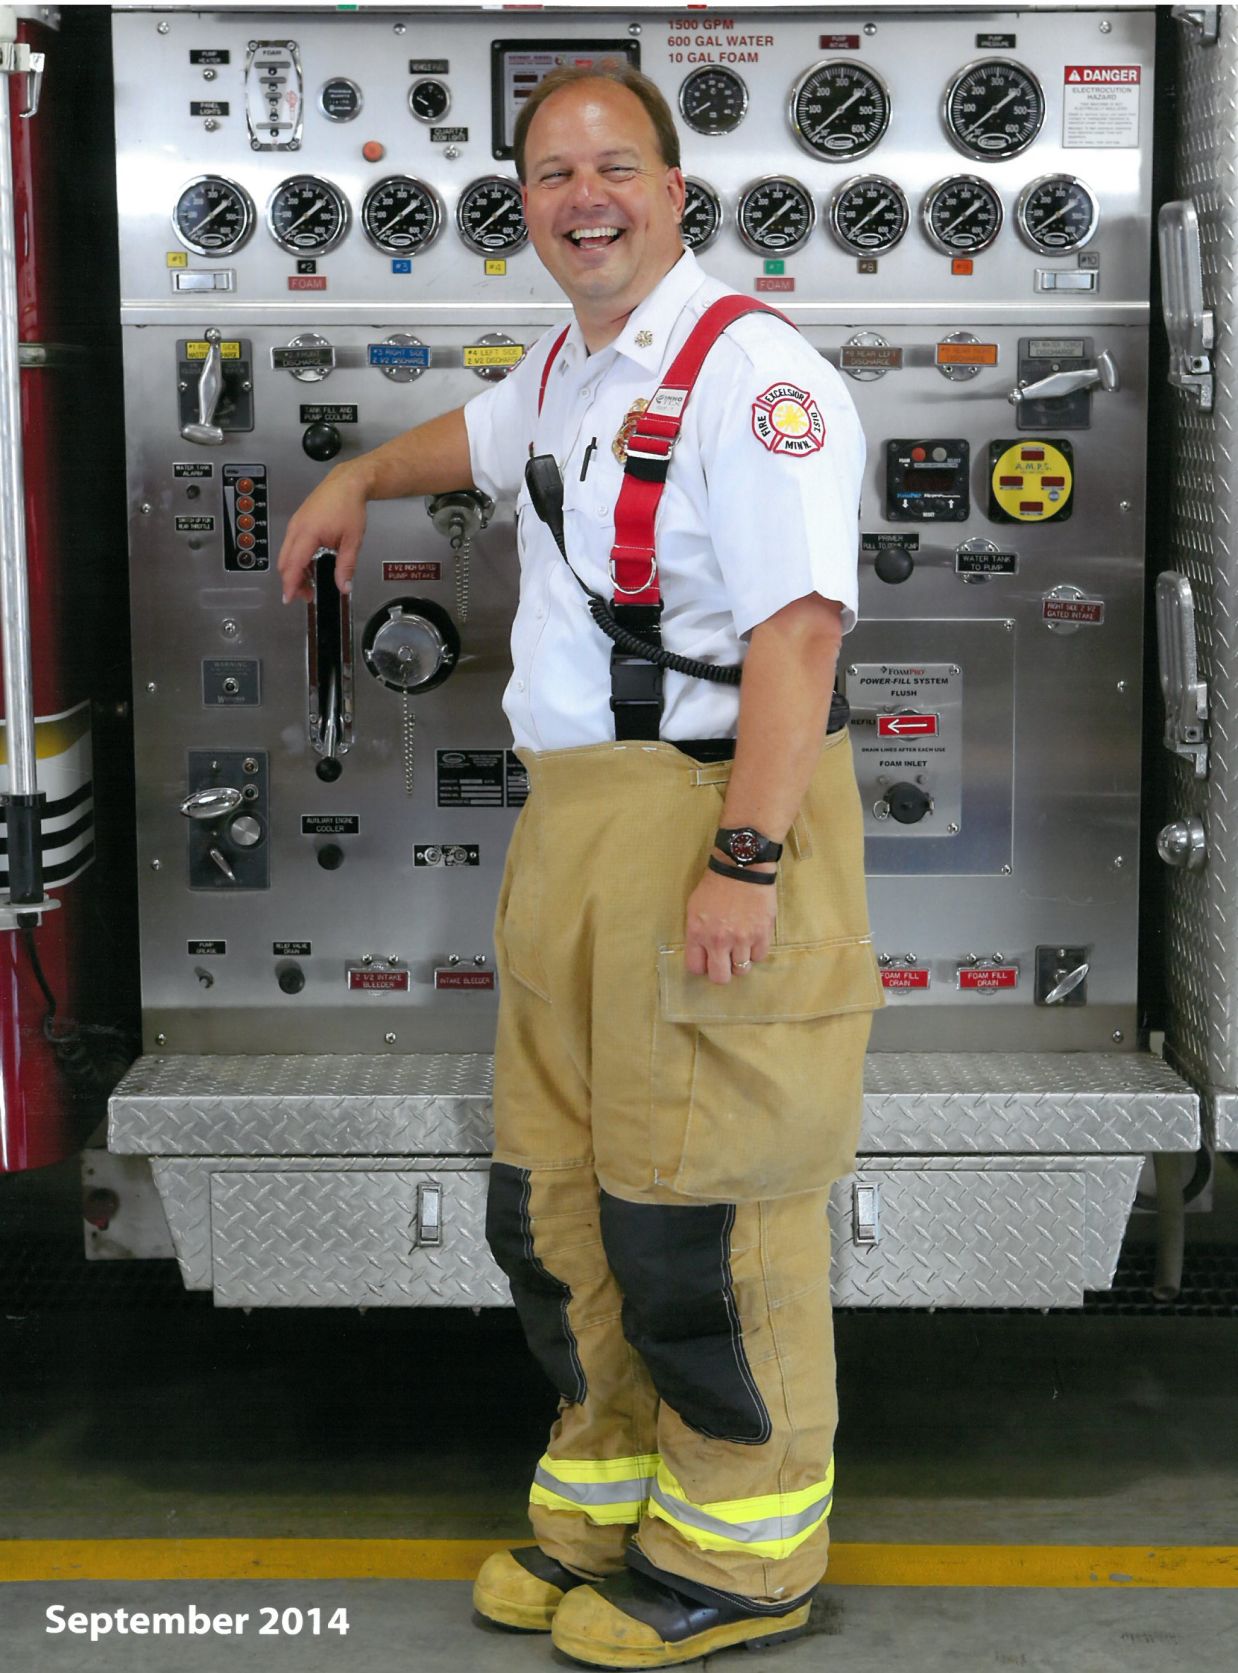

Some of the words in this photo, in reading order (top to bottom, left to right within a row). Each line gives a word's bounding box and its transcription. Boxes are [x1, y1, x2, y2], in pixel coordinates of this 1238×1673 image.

[668, 19, 698, 30] 1500
[703, 19, 734, 30] GPM
[667, 36, 691, 47] 600
[695, 36, 723, 47] GAL
[726, 36, 774, 46] WATER
[668, 53, 683, 63] 10
[687, 52, 715, 63] GAL
[719, 52, 759, 63] FOAM
[1083, 69, 1137, 81] DANGER
[817, 88, 830, 96] 200
[972, 87, 985, 95] 200
[809, 105, 821, 113] 100
[859, 107, 873, 115] 500
[963, 104, 976, 112] 100
[1013, 106, 1027, 114] 500
[1005, 124, 1019, 132] 600
[172, 255, 183, 265] #1
[1081, 255, 1098, 266] #10
[301, 262, 314, 272] #2
[396, 262, 409, 272] #3
[489, 262, 502, 272] #4
[862, 262, 875, 272] #8
[291, 280, 323, 289] FOAM
[760, 281, 791, 290] FOAM
[481, 348, 498, 356] LEFT
[851, 358, 889, 366] DISCHARGE
[764, 388, 805, 403] EXCELSIOR
[757, 415, 771, 437] FIRE
[811, 412, 821, 433] DIST
[1071, 612, 1094, 620] INTAKE
[377, 973, 402, 981] INTAKE
[968, 971, 989, 979] FOAM
[992, 971, 1008, 979] FILL
[439, 977, 462, 985] INTAKE
[463, 977, 490, 985] BLEEDER
